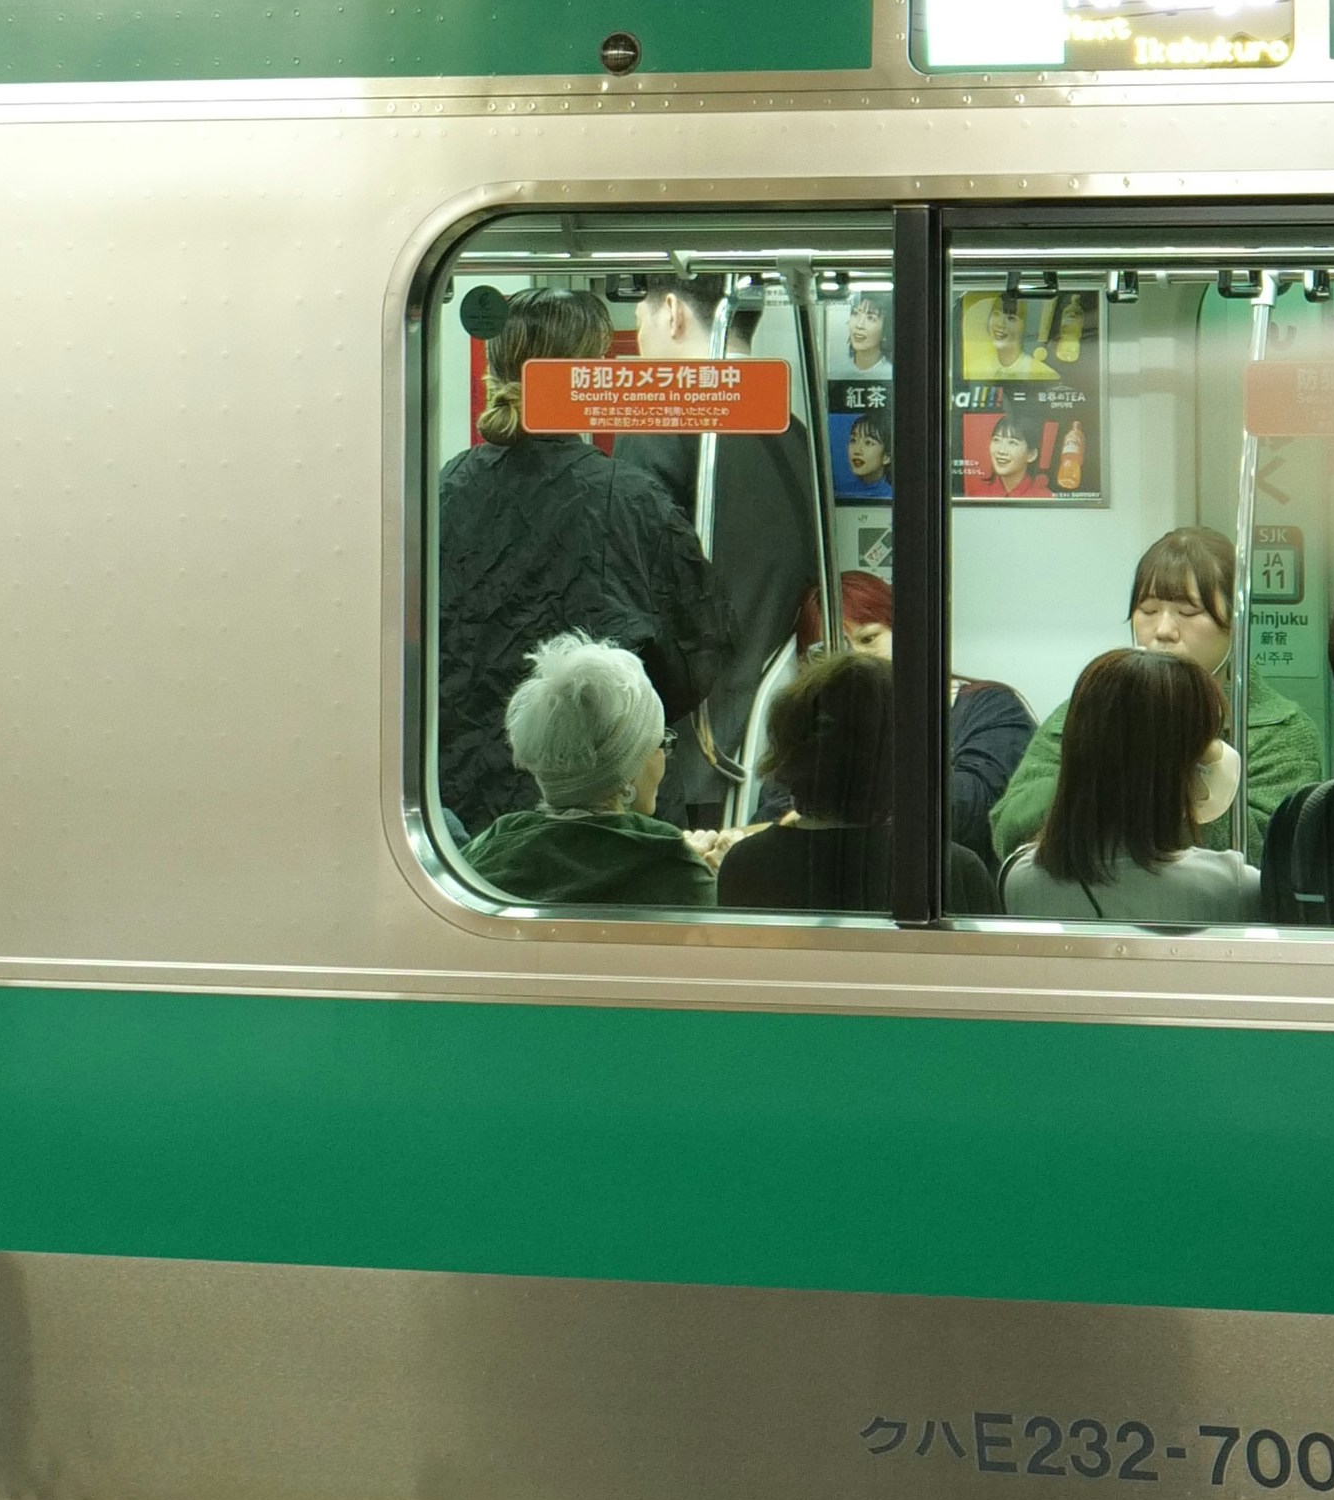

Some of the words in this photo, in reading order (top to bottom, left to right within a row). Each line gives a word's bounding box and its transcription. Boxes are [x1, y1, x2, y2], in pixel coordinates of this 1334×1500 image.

[1134, 36, 1290, 64] Ikebukuro
[570, 366, 741, 389] 防犯カメラ作動中
[570, 390, 619, 403] Security
[622, 391, 666, 402] camera
[669, 391, 680, 401] in
[683, 391, 741, 403] operation
[845, 386, 887, 409] 紅茶
[583, 406, 729, 417] お客さまに安心してご利用いただくため
[589, 417, 724, 427] 車内に防犯カメラを設置しています。
[1259, 528, 1288, 543] SJK
[1263, 552, 1284, 567] JA
[1261, 569, 1286, 589] 11
[1249, 611, 1309, 630] hinjuku
[1260, 632, 1288, 646] 新宿
[1254, 652, 1294, 666] 신주쿠
